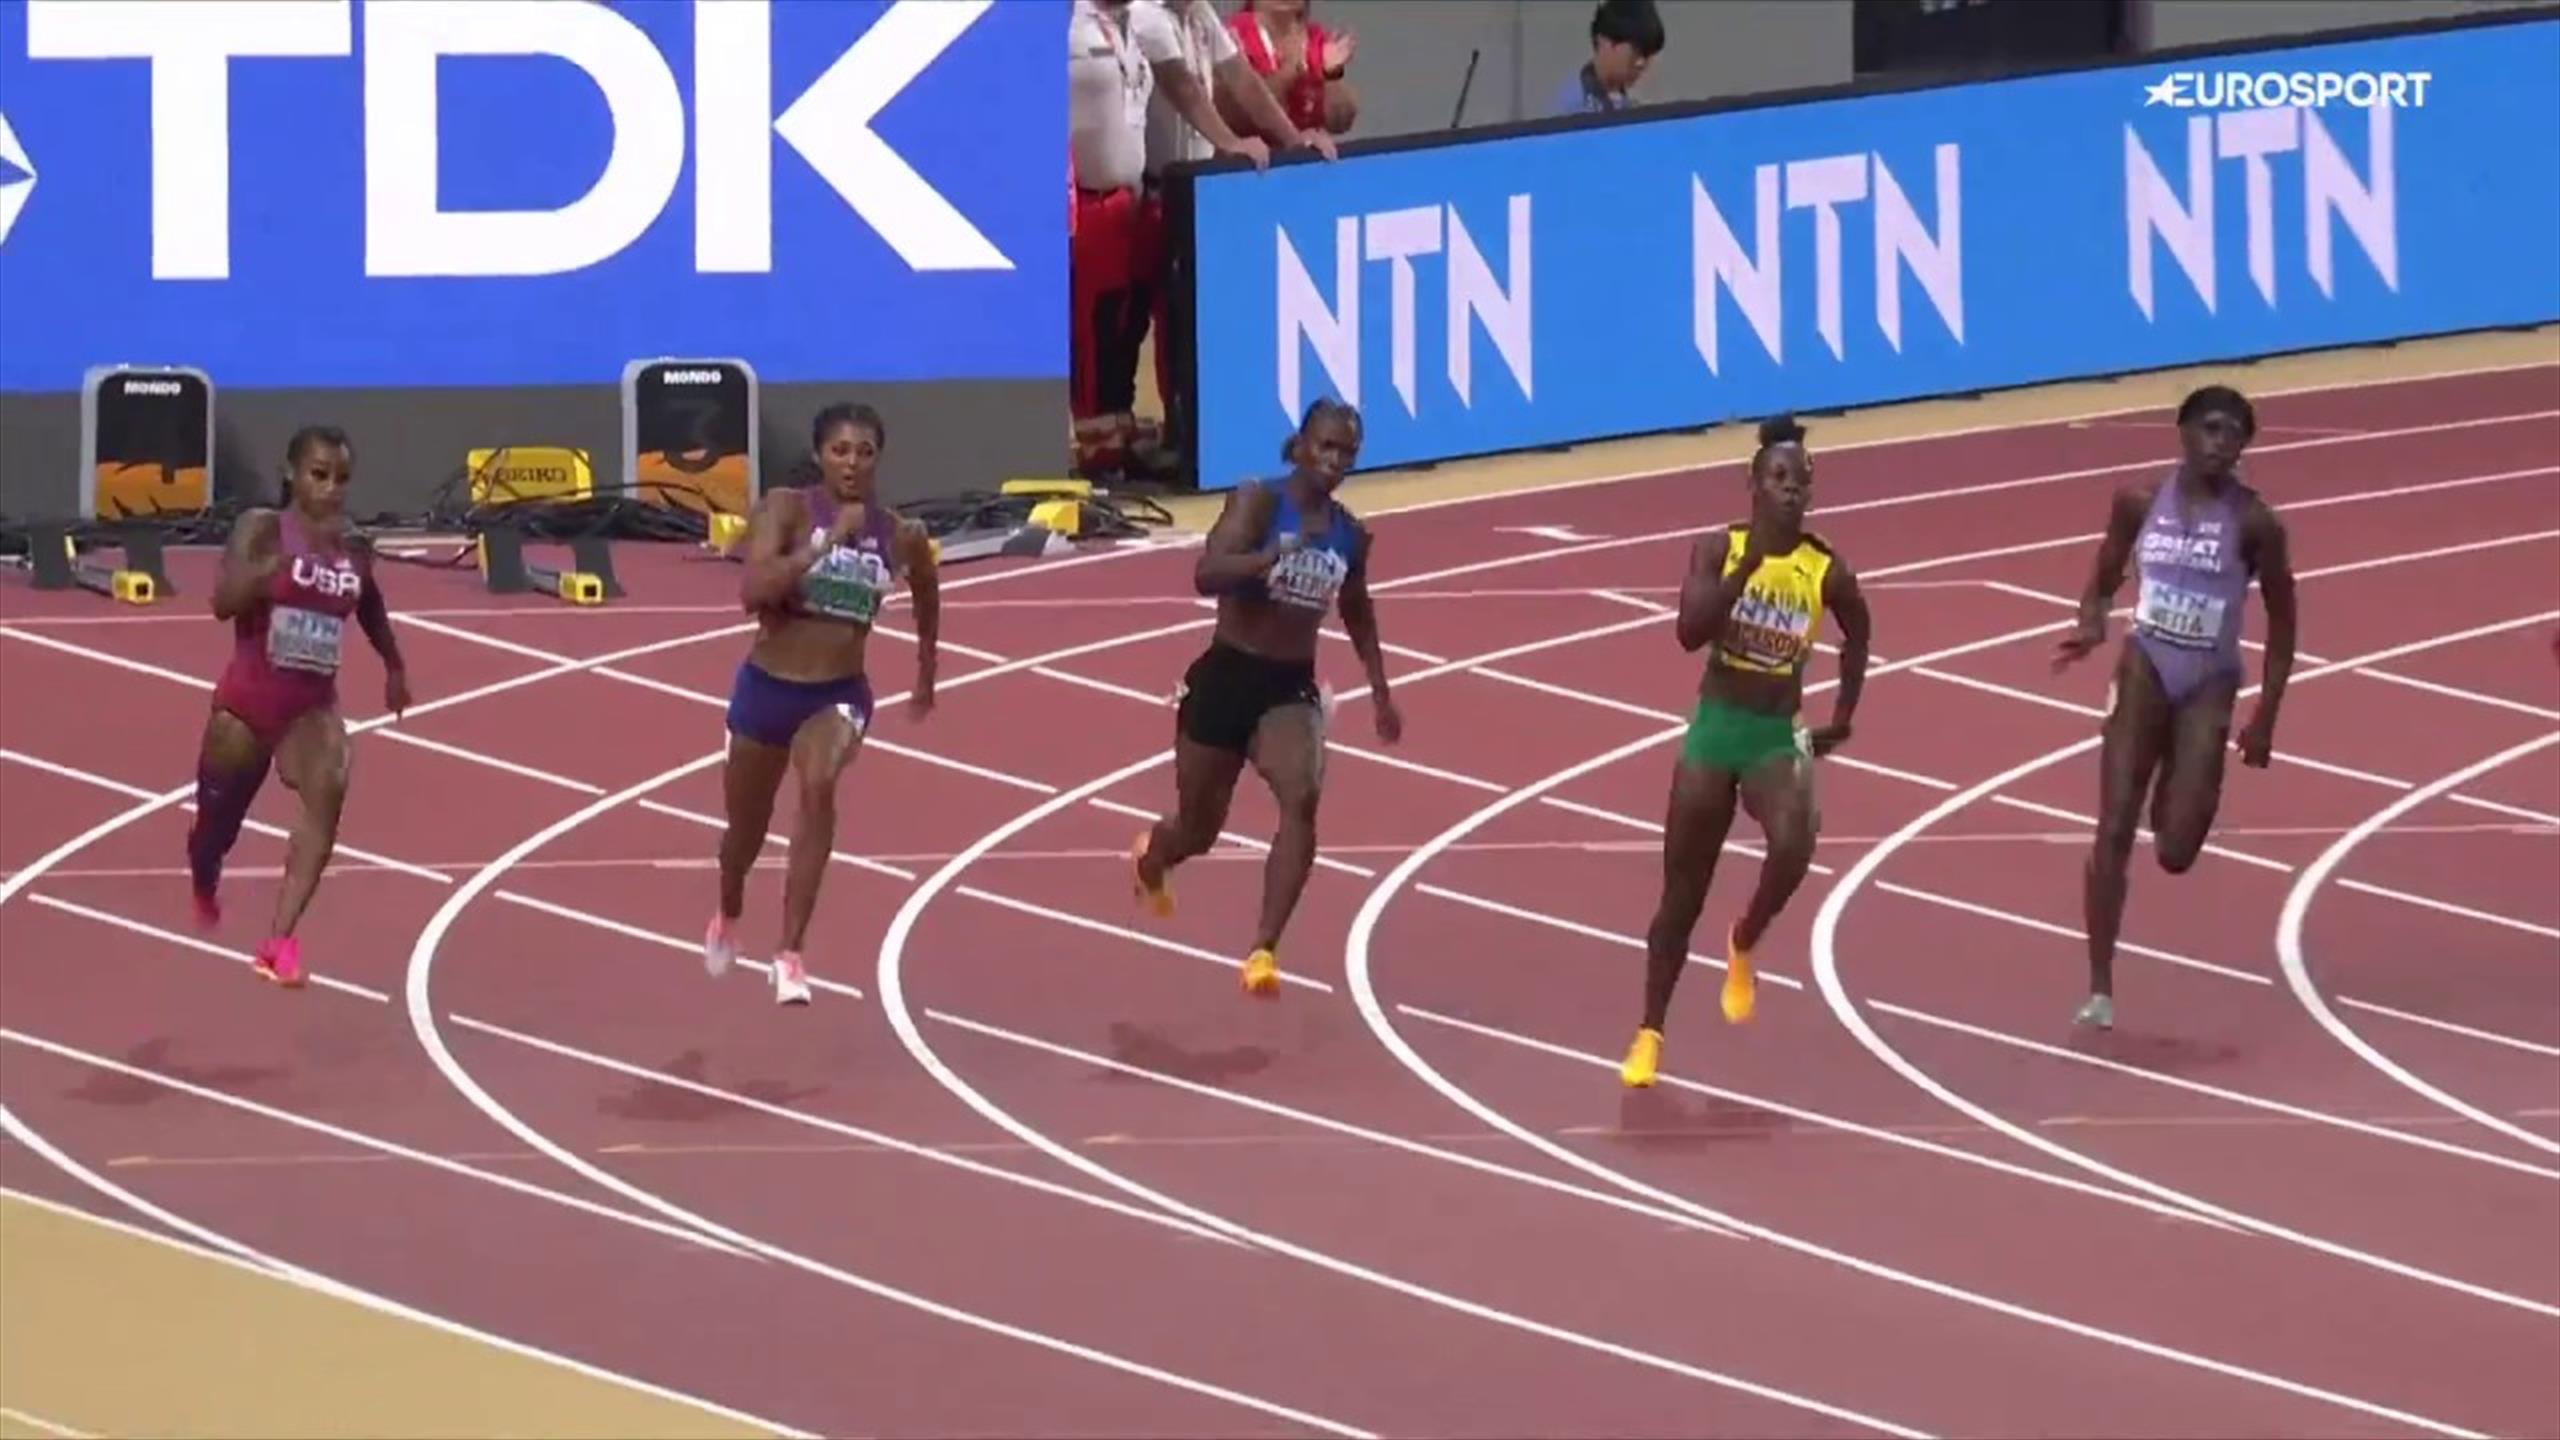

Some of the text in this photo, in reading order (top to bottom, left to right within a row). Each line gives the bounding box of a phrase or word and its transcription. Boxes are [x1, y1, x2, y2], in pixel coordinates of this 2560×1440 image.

[28, 0, 1016, 280] TDK
[1693, 143, 1965, 377] NTN
[2123, 98, 2398, 324] NTN
[663, 368, 723, 385] MONDO
[1277, 194, 1533, 429] NTN
[124, 380, 182, 396] MONDO
[292, 557, 361, 597] USA
[1737, 601, 1794, 630] NTN
